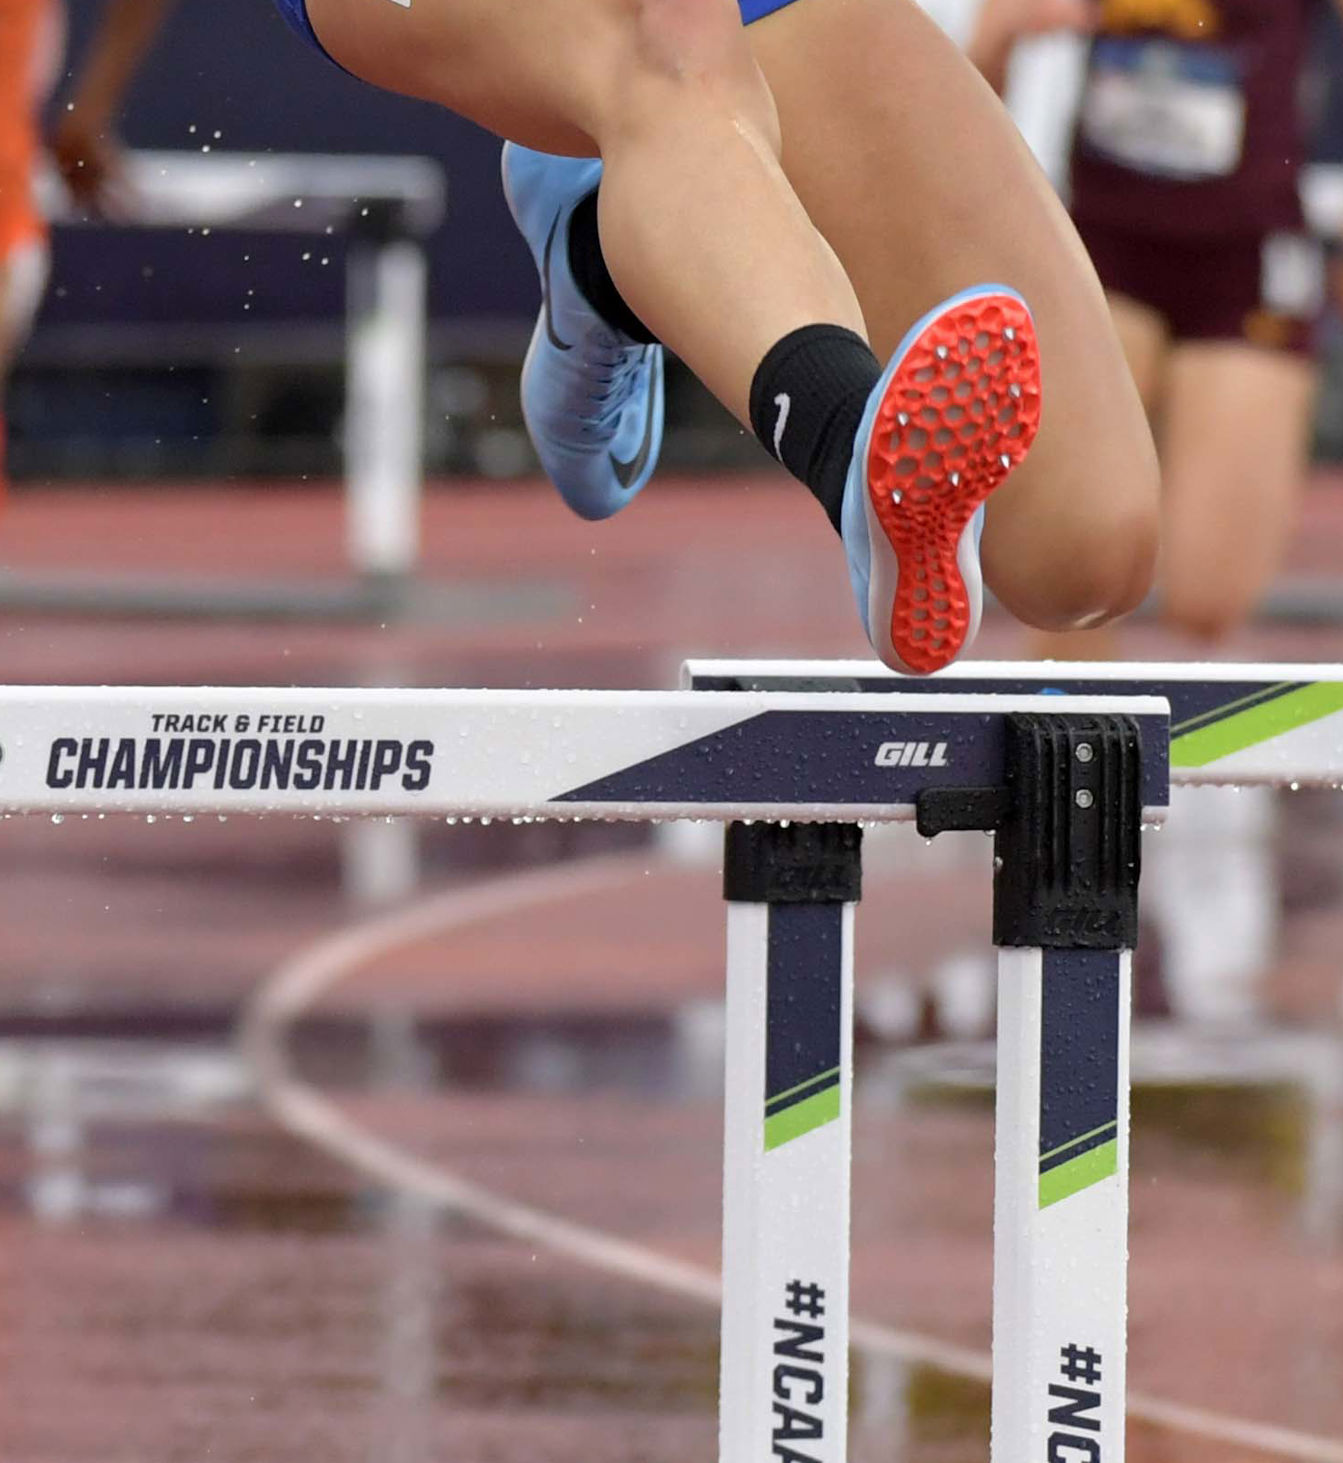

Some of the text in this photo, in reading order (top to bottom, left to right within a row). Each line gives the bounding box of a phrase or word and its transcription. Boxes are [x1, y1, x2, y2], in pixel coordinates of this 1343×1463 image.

[151, 713, 325, 733] TRACK & FIELD
[45, 737, 435, 791] CHAMPIONSHIPS
[874, 741, 949, 767] GILL
